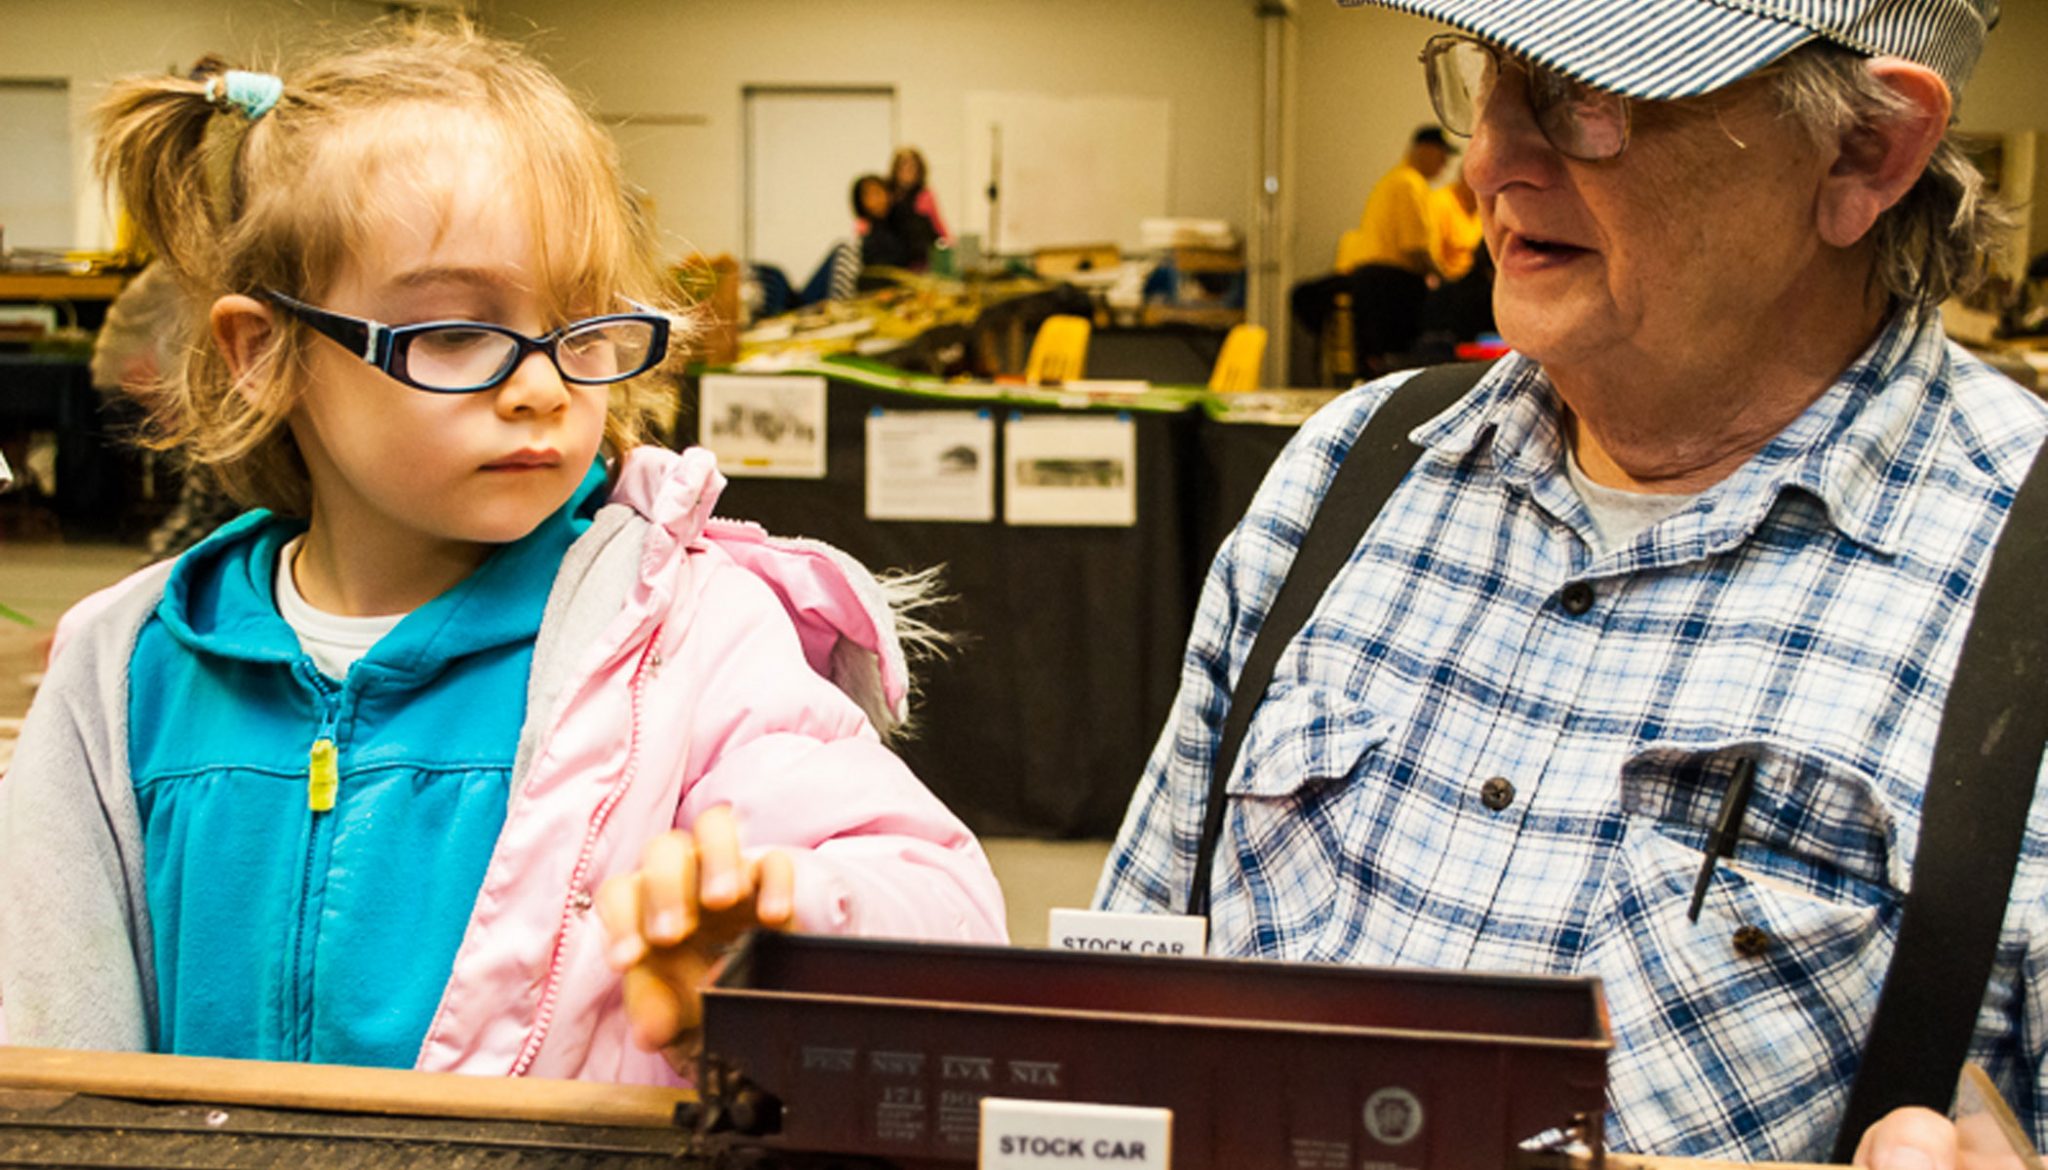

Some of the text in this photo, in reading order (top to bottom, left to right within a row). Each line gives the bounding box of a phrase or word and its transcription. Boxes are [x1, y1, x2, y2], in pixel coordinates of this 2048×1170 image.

[1062, 937, 1184, 956] STOCK CAR
[942, 1060, 992, 1081] LVA
[1010, 1065, 1061, 1086] NIA
[1001, 1136, 1145, 1160] STOCK CAR
